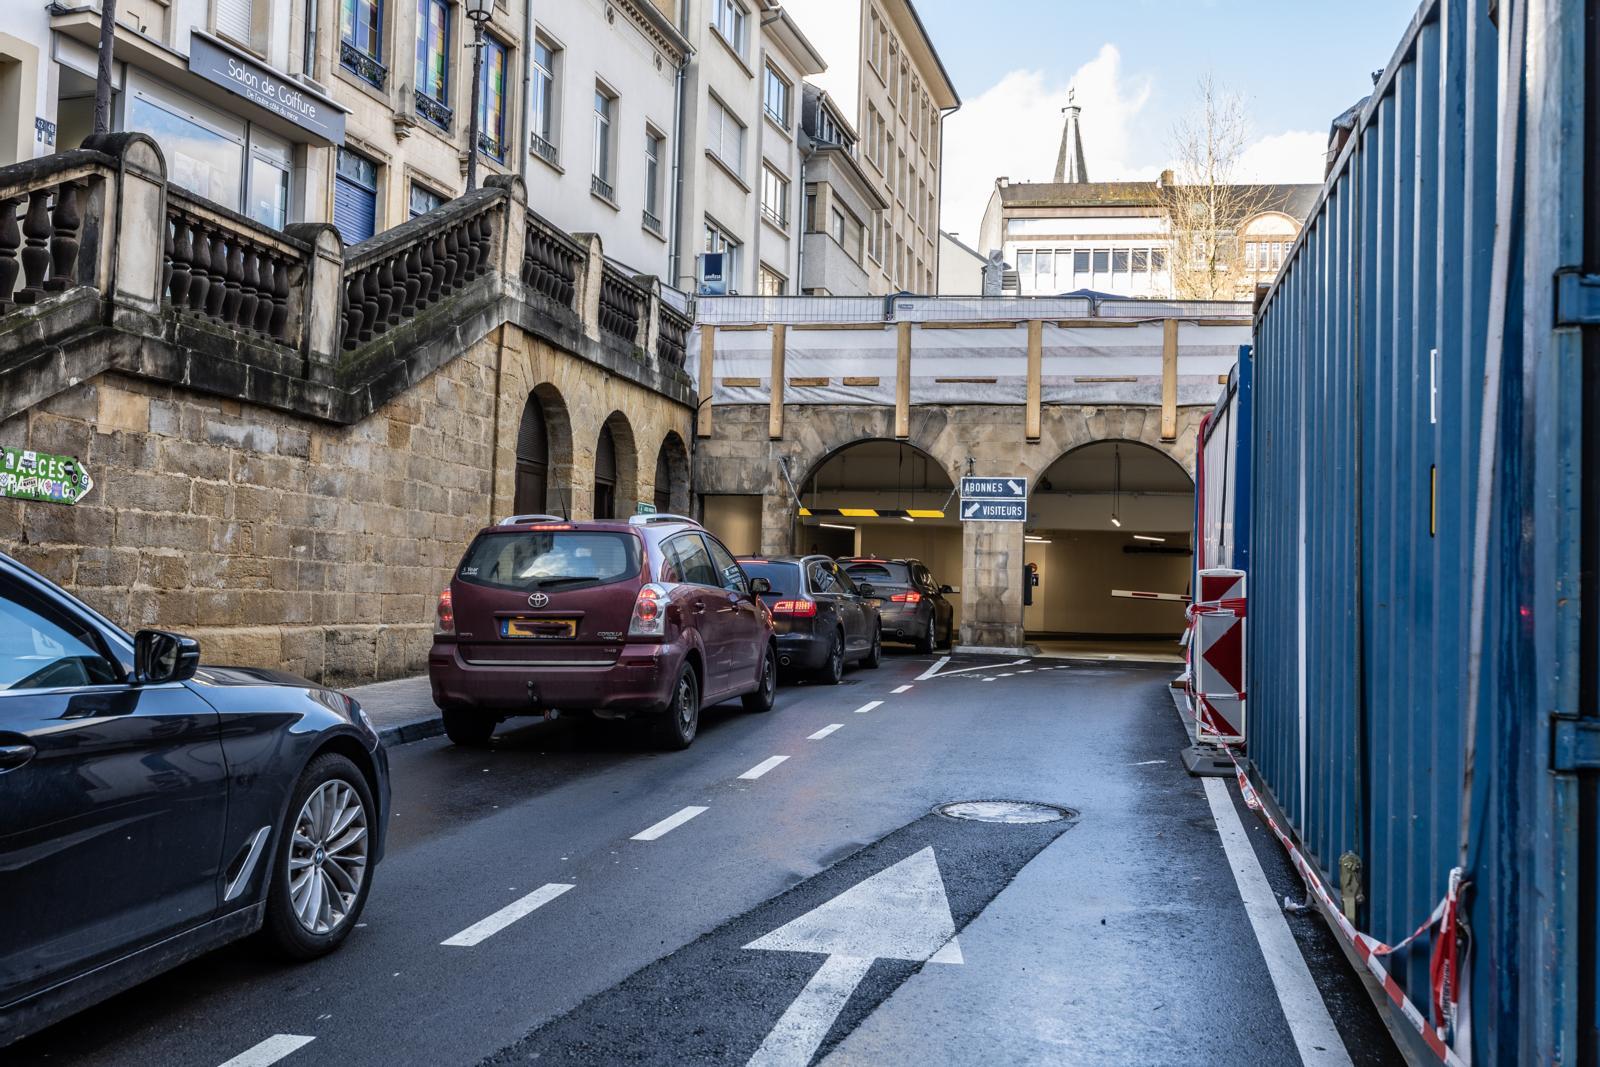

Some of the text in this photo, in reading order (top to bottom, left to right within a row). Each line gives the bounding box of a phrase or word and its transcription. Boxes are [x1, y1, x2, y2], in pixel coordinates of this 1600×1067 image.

[228, 58, 316, 118] Salon de Coiffure
[964, 482, 1003, 493] ABONNES
[982, 505, 1023, 516] VISITEURS
